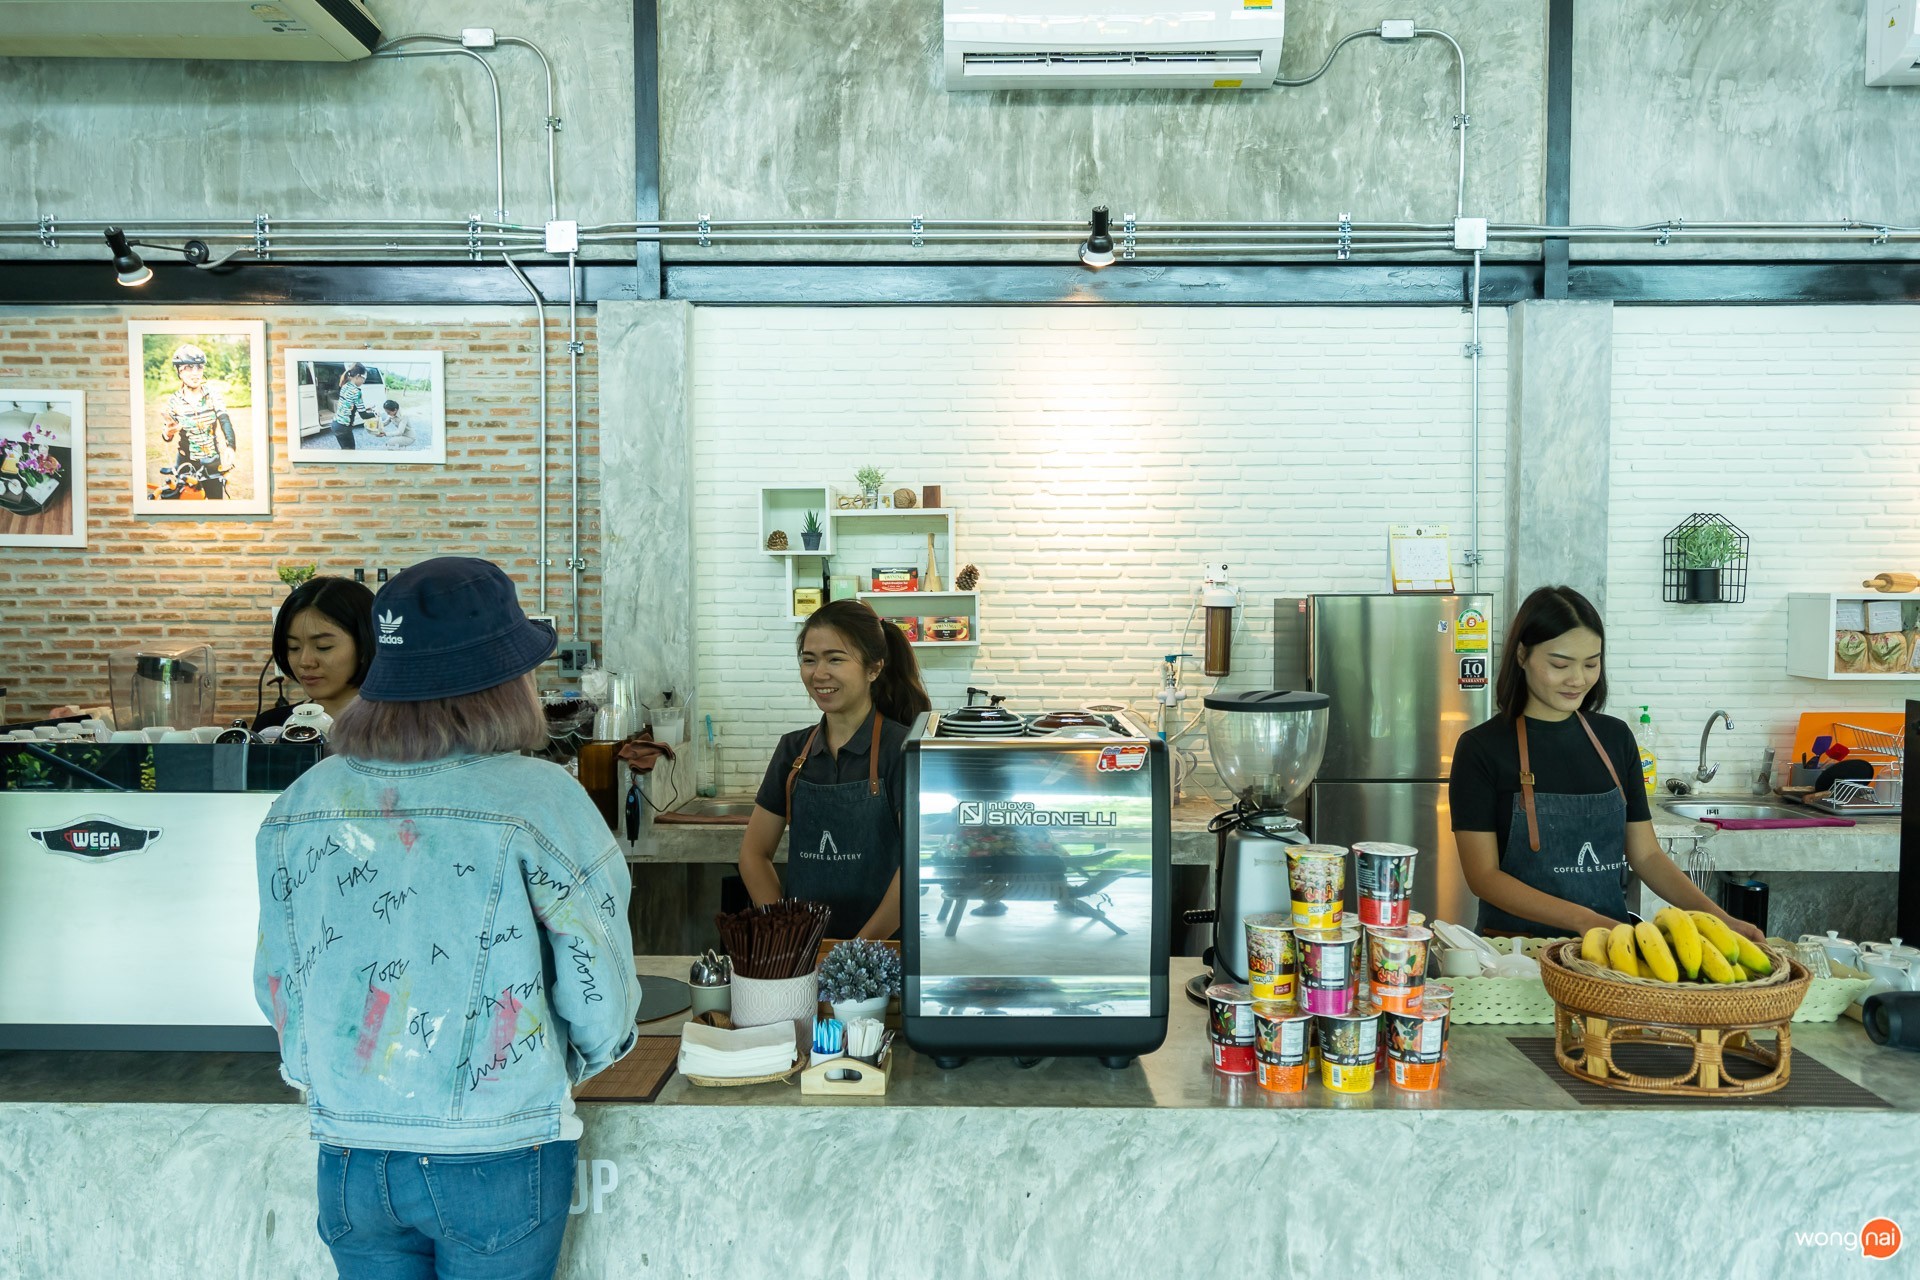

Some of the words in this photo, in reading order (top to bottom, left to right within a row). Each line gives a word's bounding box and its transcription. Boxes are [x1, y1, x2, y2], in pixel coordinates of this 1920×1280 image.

[379, 634, 403, 645] adidas
[1463, 663, 1483, 675] 10
[988, 801, 1034, 811] nuova
[988, 811, 1117, 827] SIMONELLI
[72, 832, 121, 848] WEGA
[799, 851, 824, 860] COFFEE
[833, 852, 861, 861] EATERY
[452, 863, 475, 877] to
[1553, 866, 1584, 874] COFFEE
[336, 860, 378, 897] HAS
[431, 943, 449, 965] A
